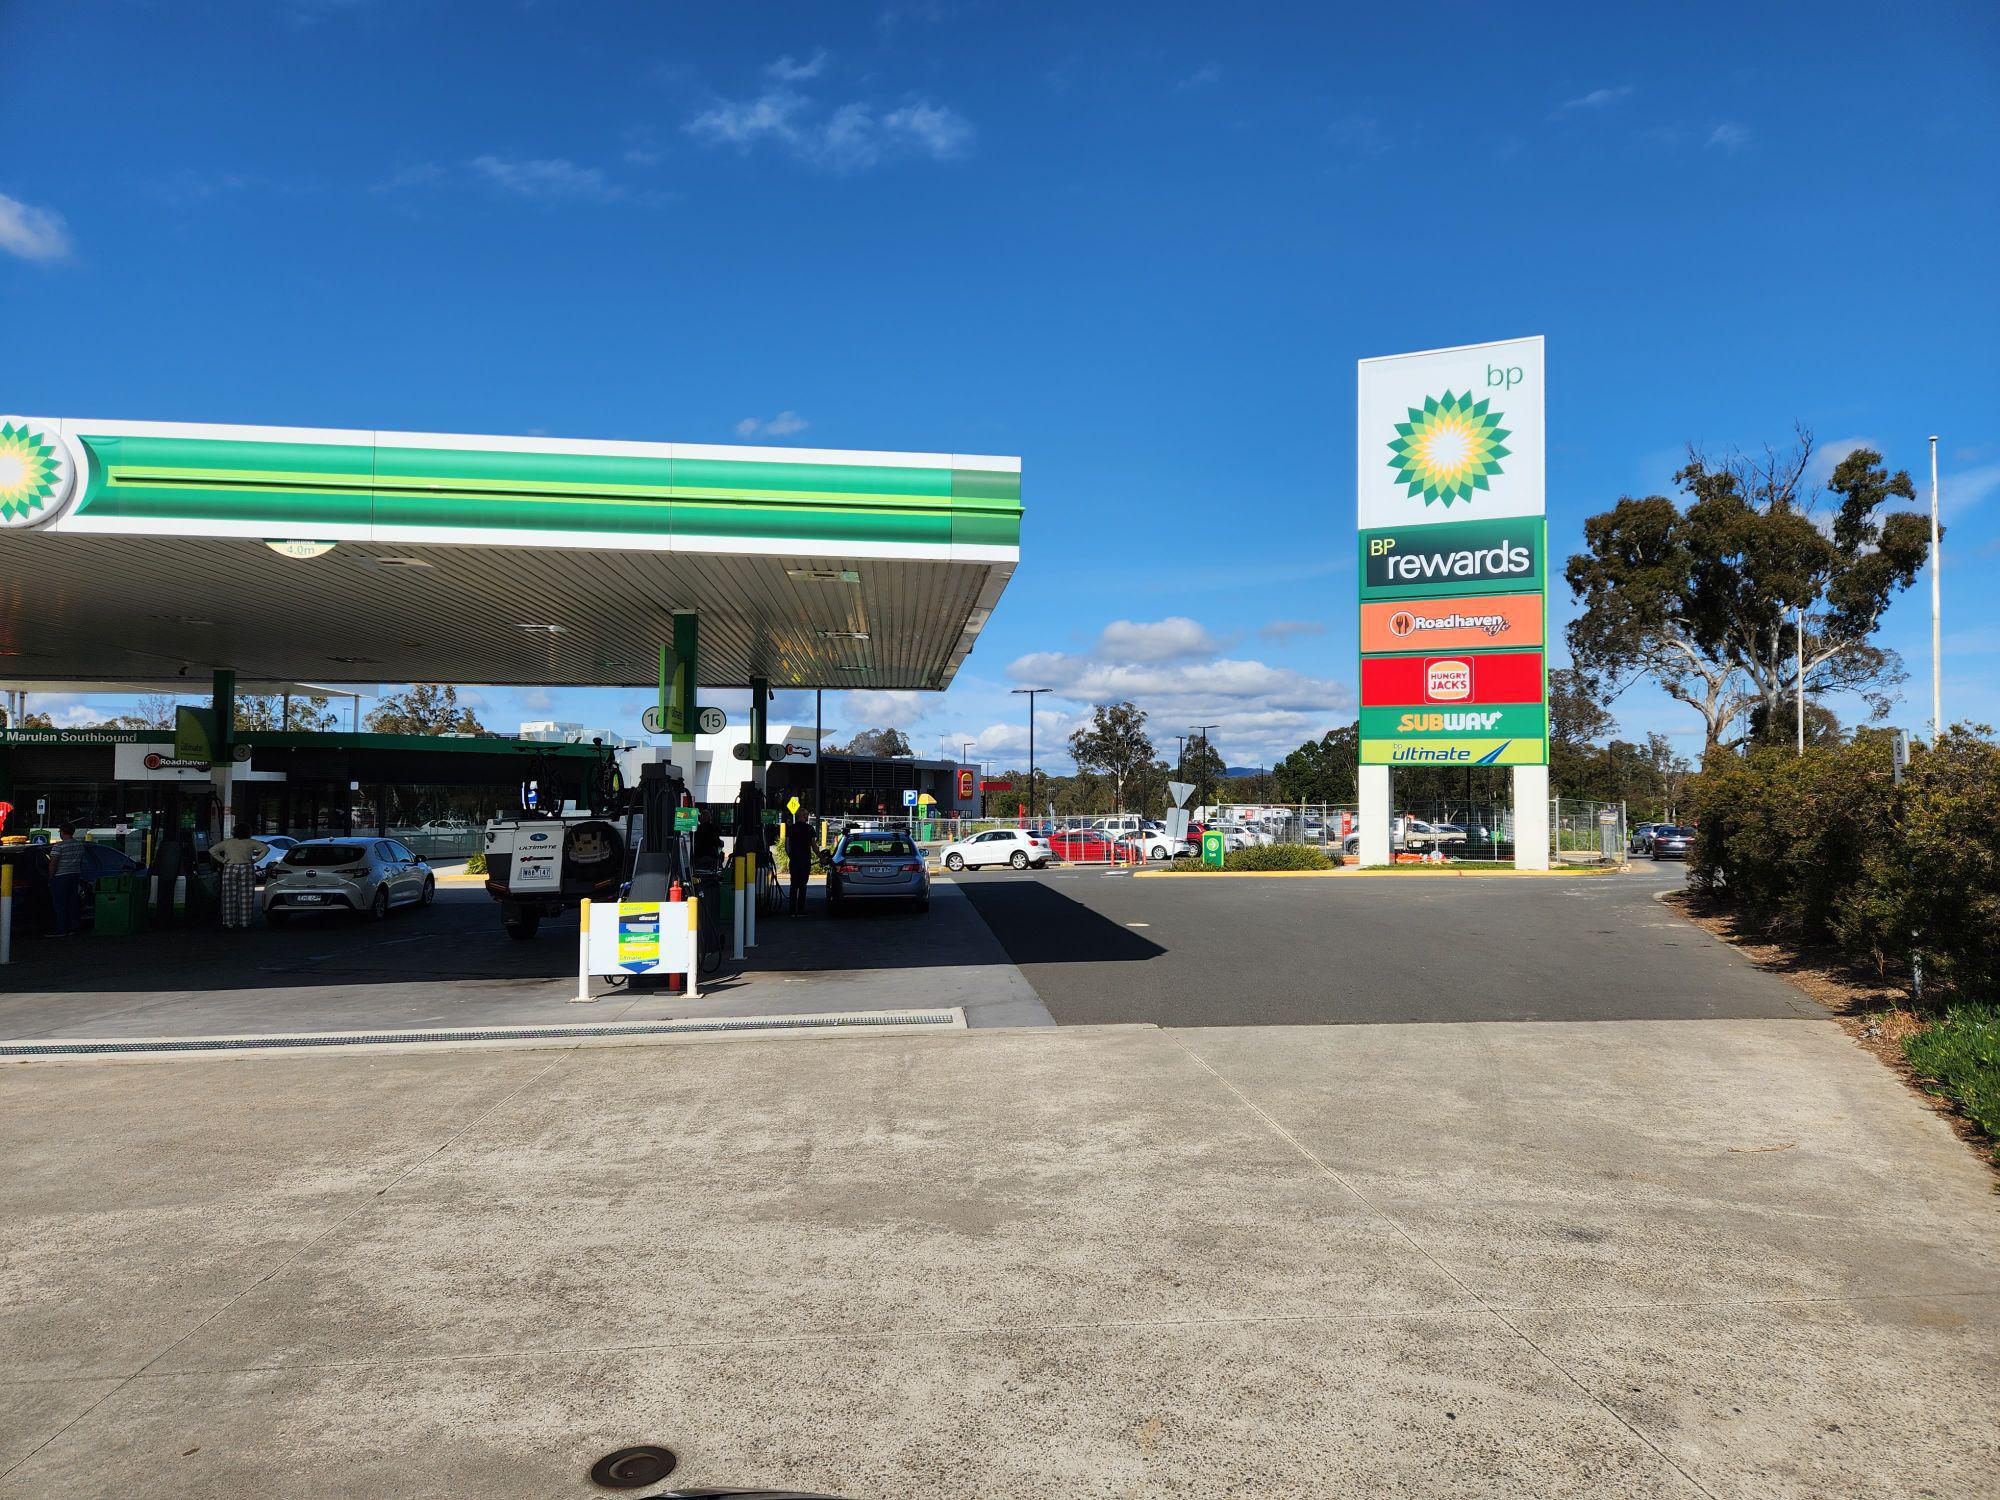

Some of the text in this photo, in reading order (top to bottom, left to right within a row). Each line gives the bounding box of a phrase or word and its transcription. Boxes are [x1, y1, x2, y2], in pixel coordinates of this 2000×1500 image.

[1487, 364, 1523, 390] bp
[1370, 538, 1396, 556] BP
[1388, 540, 1530, 580] rewards
[1414, 614, 1503, 630] Roadhaven
[1431, 672, 1468, 680] HUNGRY
[703, 714, 721, 728] 15
[1396, 711, 1503, 732] SUBWAY
[6, 731, 57, 742] Marulan
[60, 731, 137, 743] Southbound
[237, 747, 245, 758] 3
[738, 747, 745, 757] 2
[1392, 747, 1471, 761] ultimate
[905, 791, 915, 805] P
